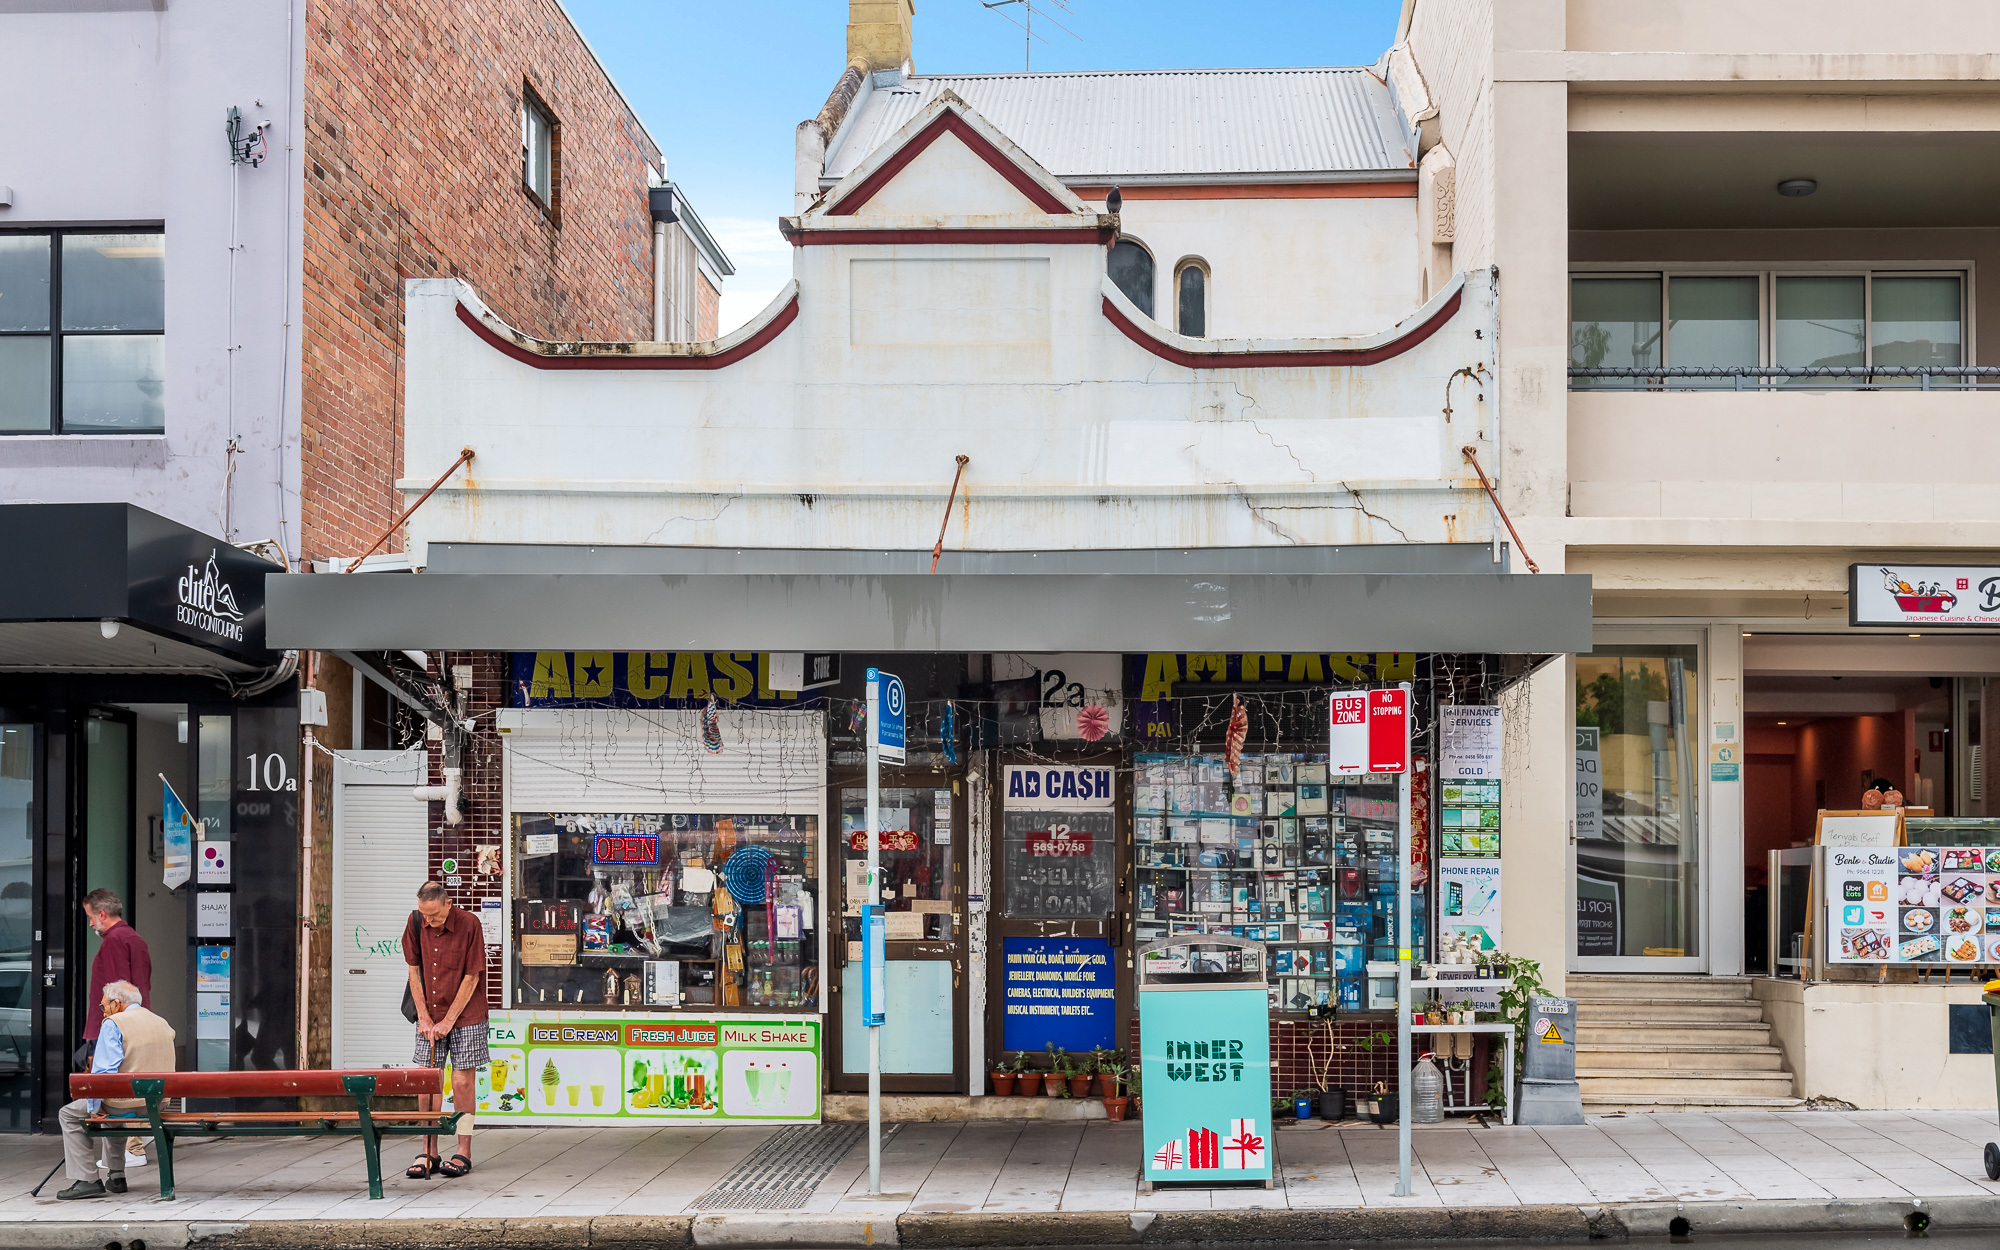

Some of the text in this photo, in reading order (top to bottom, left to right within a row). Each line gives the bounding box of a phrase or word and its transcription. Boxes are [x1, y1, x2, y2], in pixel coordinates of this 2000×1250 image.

[178, 565, 213, 612] elite
[177, 604, 243, 642] BODY CONTOURING
[1905, 615, 1938, 623] Japanese
[530, 652, 613, 697] AD
[892, 688, 898, 708] B
[1335, 698, 1362, 711] BUS
[1382, 693, 1393, 703] NO
[1336, 711, 1361, 723] ZONE
[1372, 705, 1402, 716] STOPPING
[1462, 708, 1499, 717] FINANCE
[1450, 718, 1491, 726] SERVICES
[246, 753, 297, 792] 10a
[1458, 767, 1483, 775] GOLD
[1009, 770, 1040, 798] AD
[1048, 823, 1070, 839] 12
[856, 834, 914, 844] 出平安
[596, 837, 656, 861] OPEN
[1033, 843, 1085, 852] 569-0758
[1834, 853, 1861, 866] Bento
[1868, 853, 1896, 866] Studio
[1441, 867, 1500, 875] PHONE REPAIR
[1007, 954, 1022, 964] PAWN
[1022, 954, 1035, 964] YOUR
[1036, 954, 1047, 965] CAR,
[1036, 971, 1063, 982] DIAMONDS,
[1083, 971, 1096, 981] FONE
[1007, 988, 1032, 999] CAMERAS,
[1032, 988, 1060, 999] ELECTRICAL,
[1007, 1005, 1028, 1015] MUSICAL
[1029, 1005, 1060, 1016] INSTRUMENT,
[1060, 1005, 1080, 1015] TABLETS
[533, 1028, 618, 1042] ICE CREAM
[632, 1028, 715, 1043] FRESH JUICE
[724, 1030, 808, 1044] MILK SHAKE
[1166, 1039, 1244, 1060] INNER
[1167, 1062, 1244, 1082] WEST
